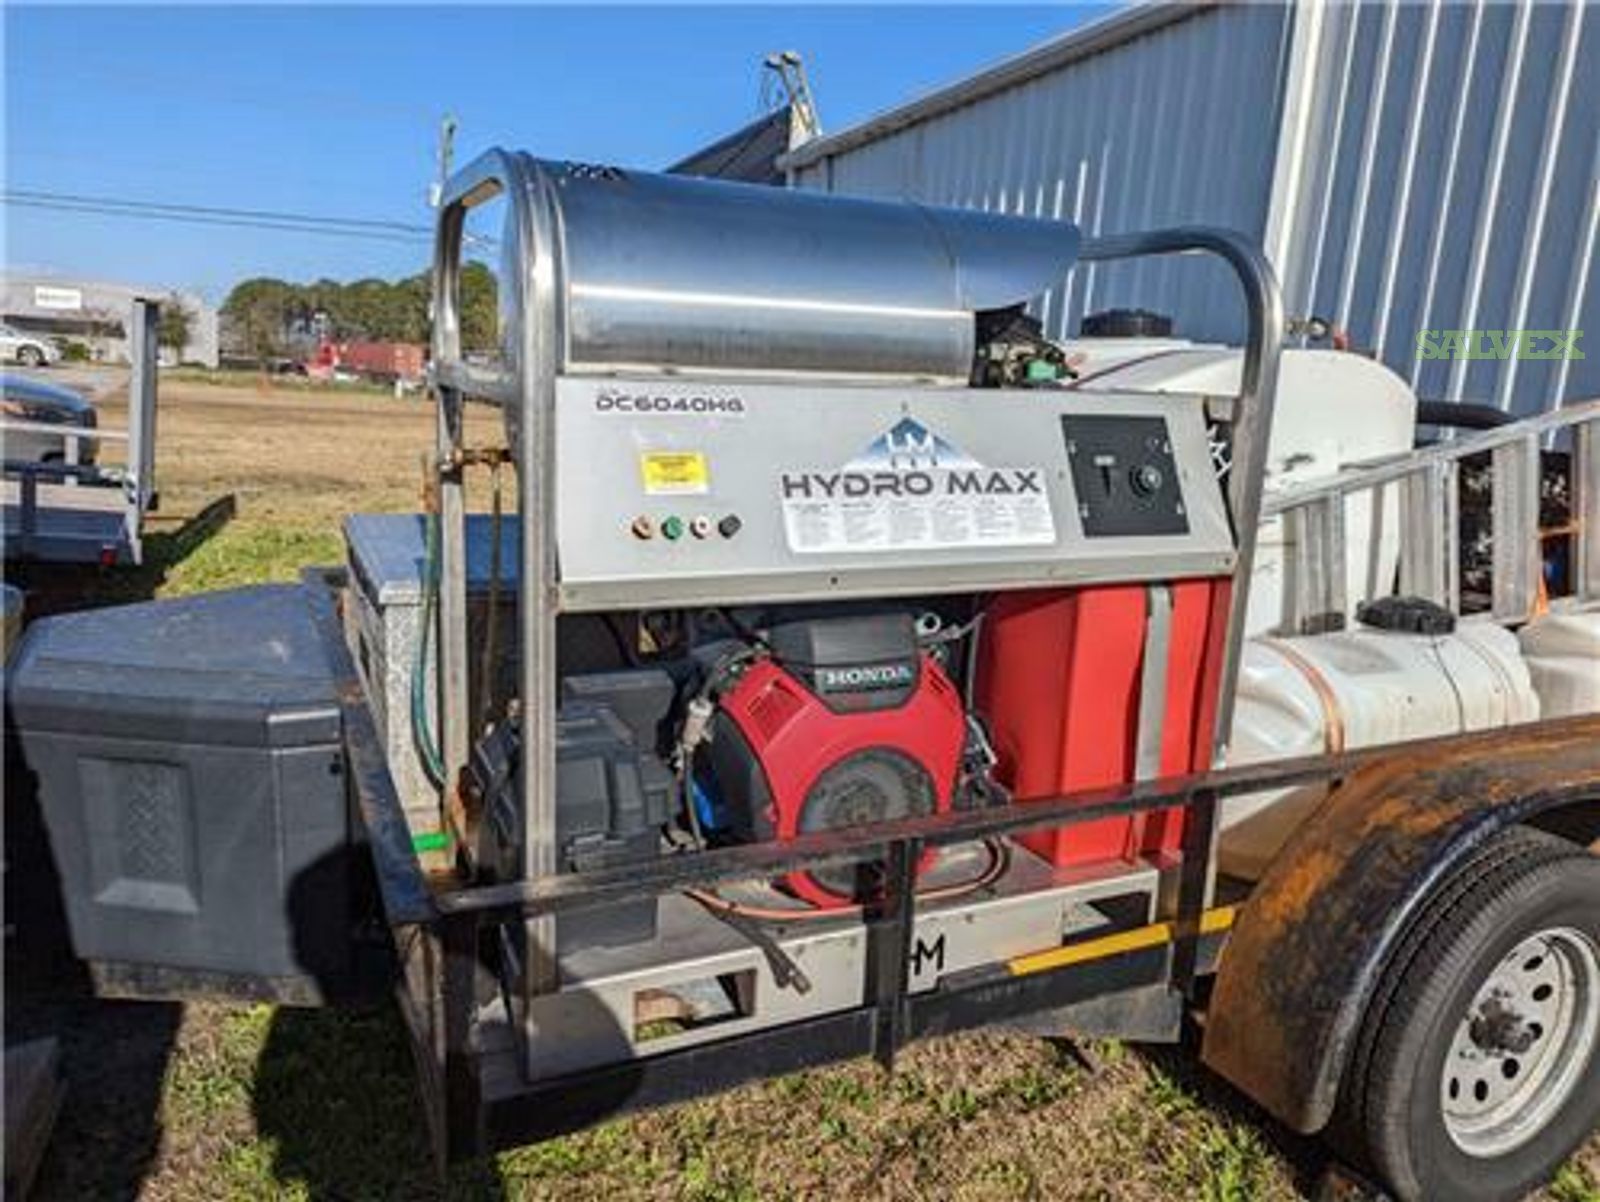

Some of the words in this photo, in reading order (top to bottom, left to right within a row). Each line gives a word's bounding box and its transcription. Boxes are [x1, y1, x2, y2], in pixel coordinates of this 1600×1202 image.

[782, 471, 934, 498] HYDRO
[947, 470, 1041, 495] MAX
[826, 666, 914, 685] HONDA
